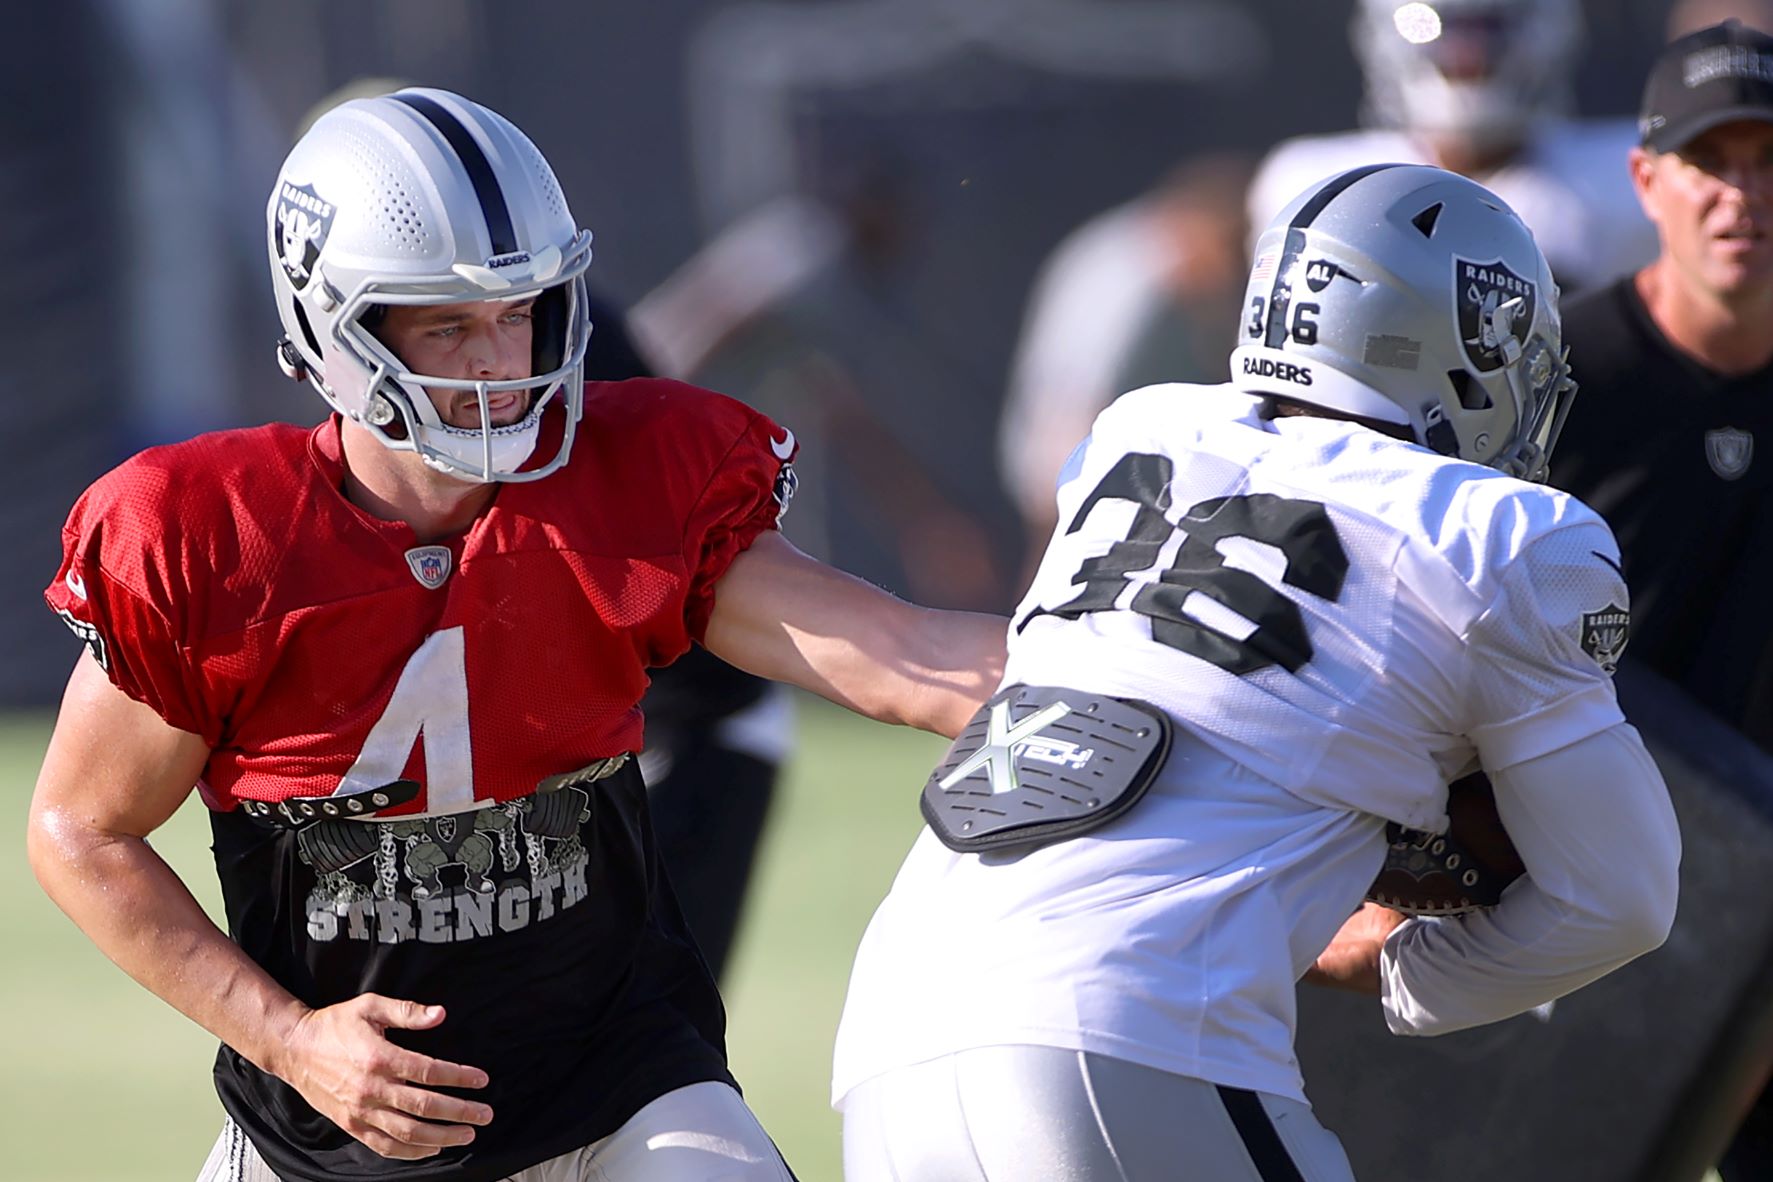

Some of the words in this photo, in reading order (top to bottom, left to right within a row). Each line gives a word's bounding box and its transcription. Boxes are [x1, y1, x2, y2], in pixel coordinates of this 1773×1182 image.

[281, 182, 332, 219] RAIDERS
[489, 253, 530, 269] RAIDERS
[1306, 264, 1330, 282] AL
[1466, 264, 1531, 297] RAIDERS
[1243, 357, 1313, 386] RAIDERS
[1016, 451, 1350, 675] 36
[1589, 613, 1631, 626] RAIDERS
[331, 625, 475, 815] 4
[305, 852, 588, 943] STRENGTH
